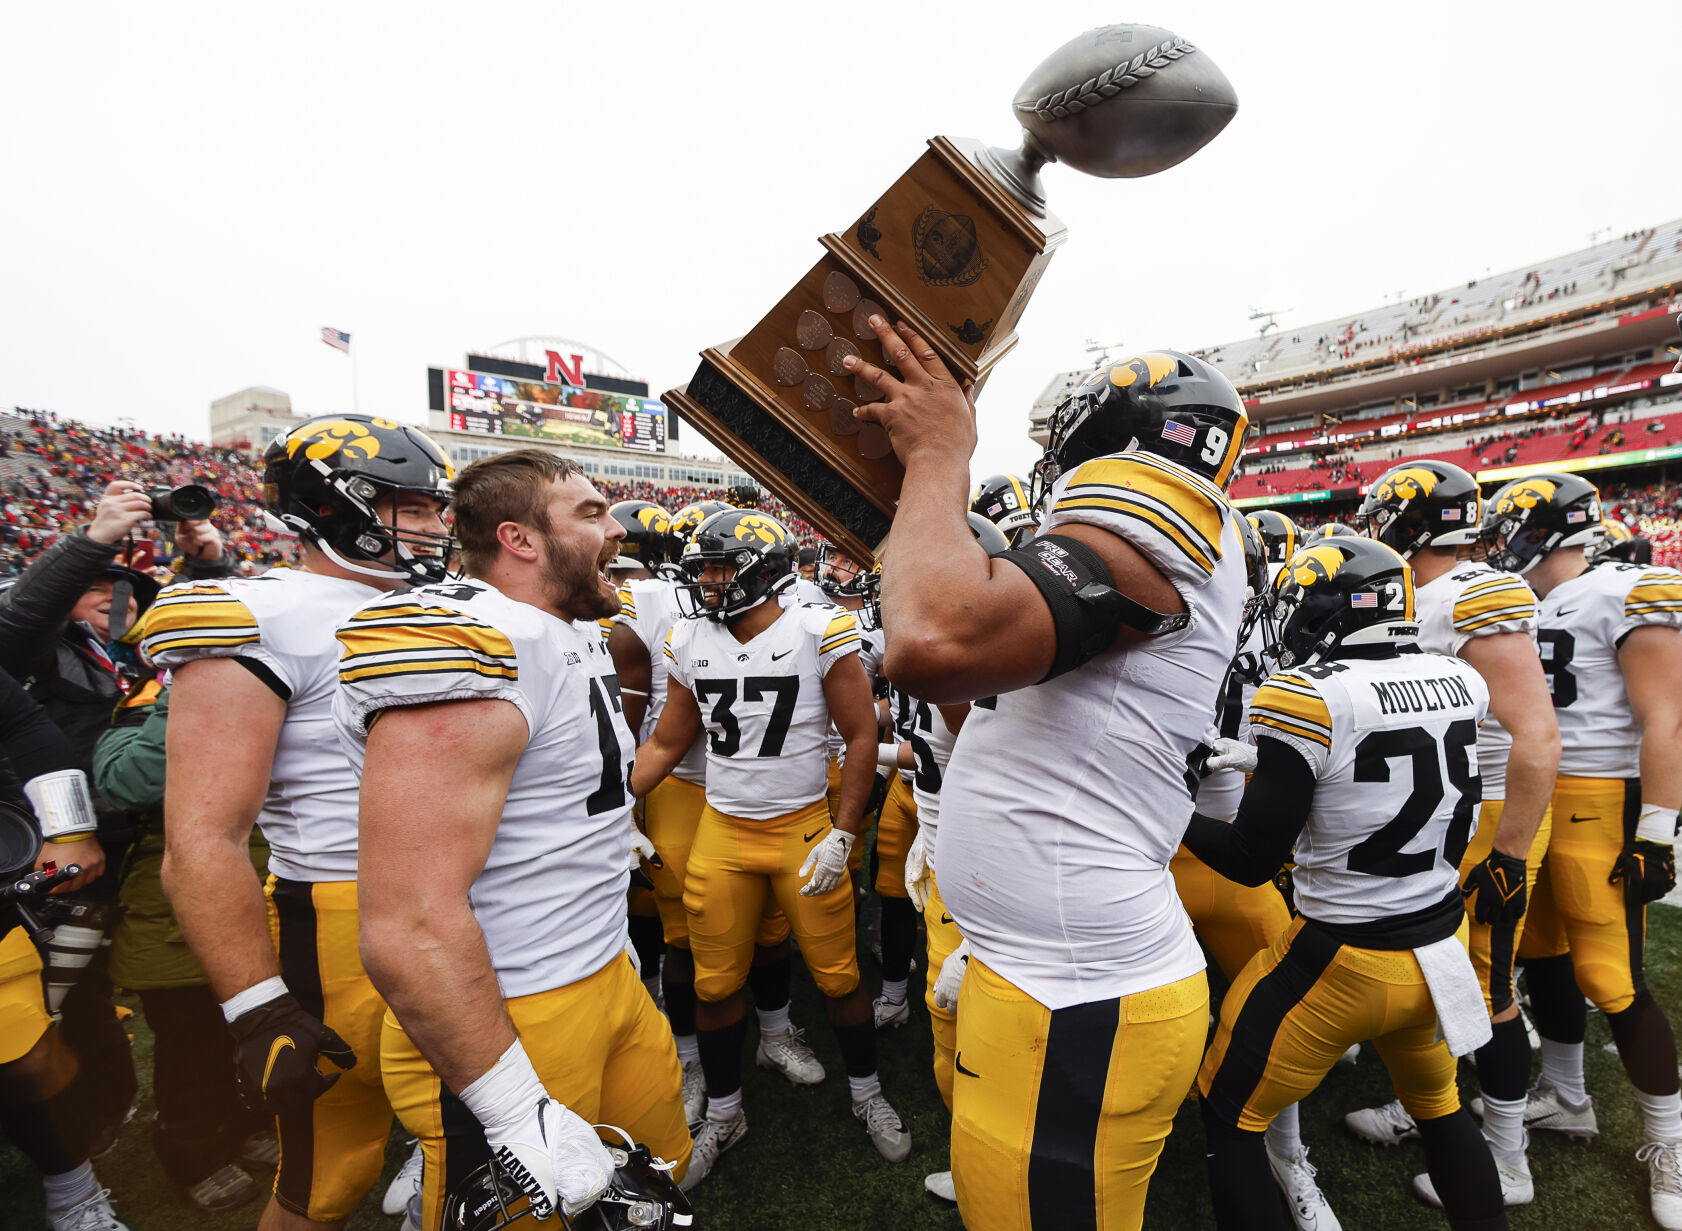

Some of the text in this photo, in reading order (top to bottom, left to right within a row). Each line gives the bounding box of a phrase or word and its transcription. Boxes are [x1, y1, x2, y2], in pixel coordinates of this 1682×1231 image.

[543, 349, 586, 388] N
[1201, 426, 1228, 466] 9
[1003, 492, 1018, 510] 9
[1466, 501, 1477, 523] 8
[1588, 501, 1600, 521] 4
[1035, 541, 1069, 557] PRO
[1038, 551, 1077, 582] GEAR
[1386, 583, 1404, 610] 2
[1370, 675, 1474, 715] MOULTON
[694, 675, 799, 757] 37
[1347, 717, 1482, 878] 28
